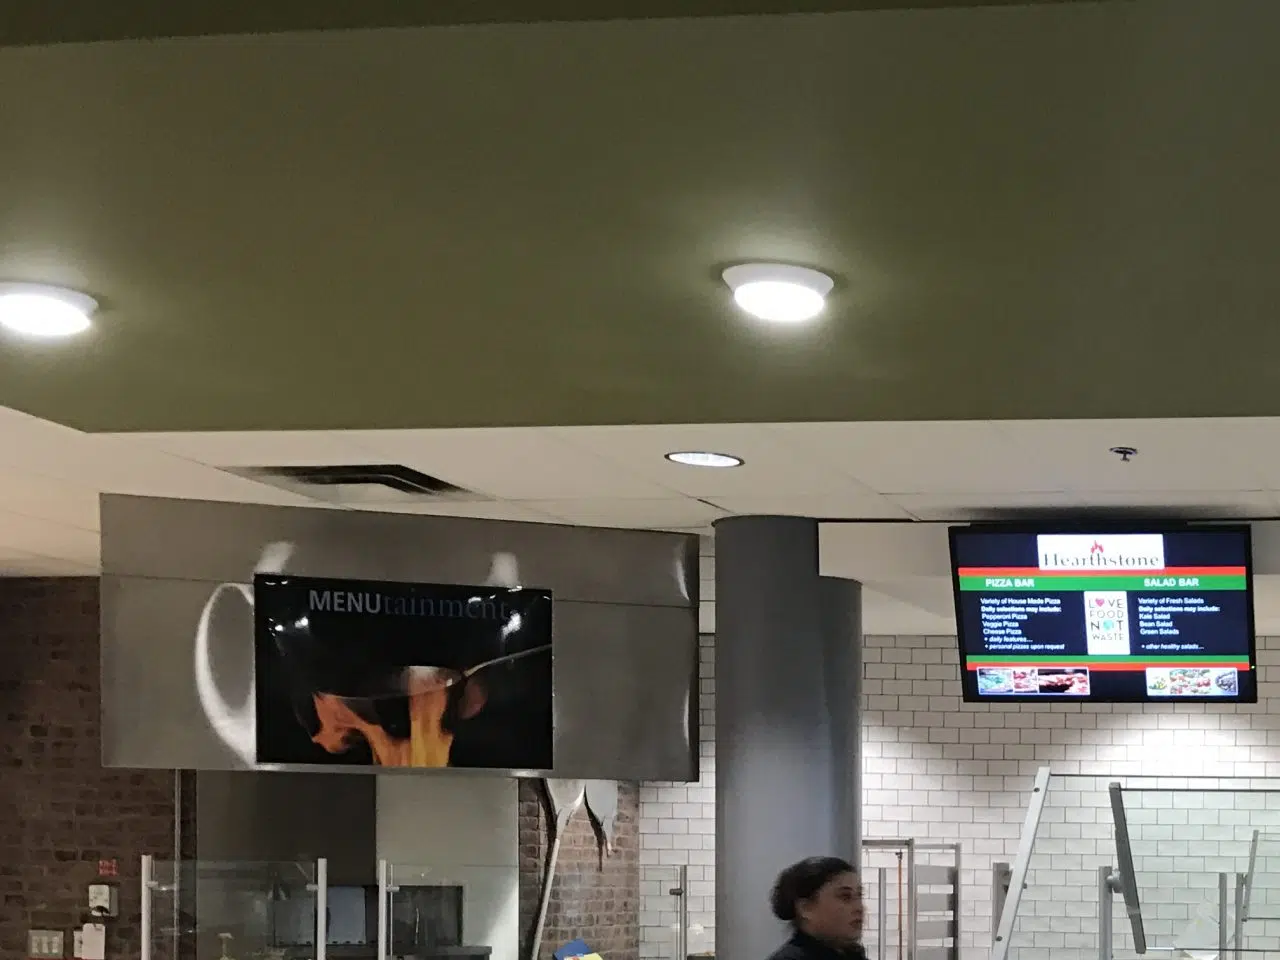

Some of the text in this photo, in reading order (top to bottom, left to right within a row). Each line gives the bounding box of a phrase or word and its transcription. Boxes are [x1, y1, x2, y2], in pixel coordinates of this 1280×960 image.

[1044, 551, 1160, 567] Hearthstone
[985, 578, 1035, 588] PIZZA BAR
[1144, 578, 1200, 587] SALAD BAR
[1089, 610, 1125, 619] FOOD
